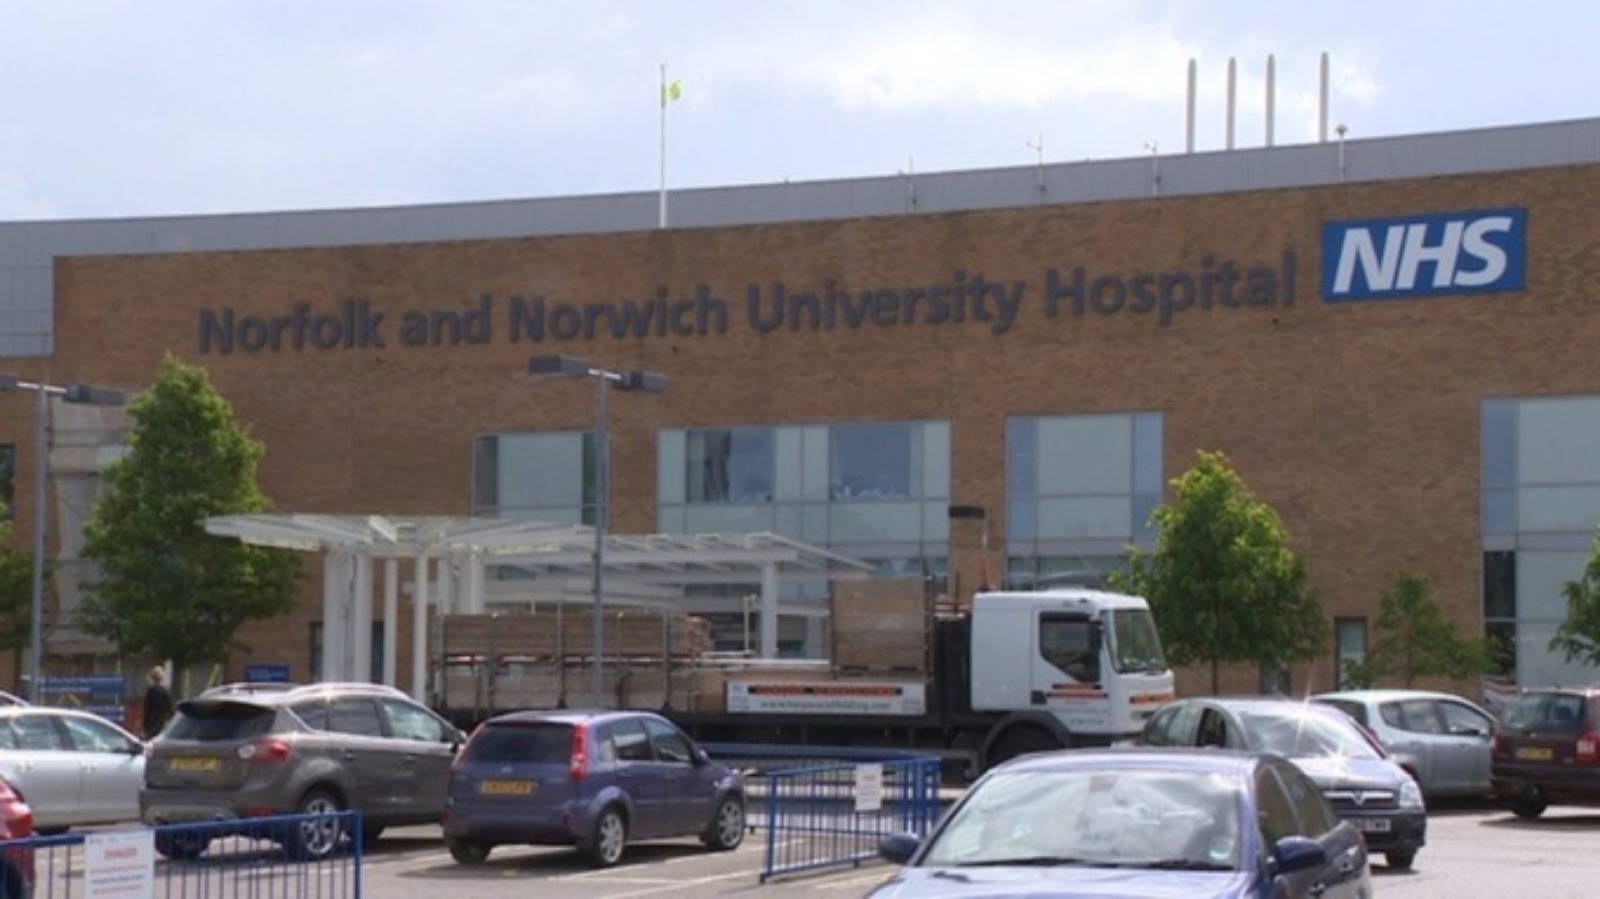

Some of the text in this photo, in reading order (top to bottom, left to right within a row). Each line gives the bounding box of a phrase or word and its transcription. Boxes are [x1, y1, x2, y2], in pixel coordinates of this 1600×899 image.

[1333, 216, 1513, 293] NHS
[199, 250, 1297, 355] Norfolk and Norwich University Hospital
